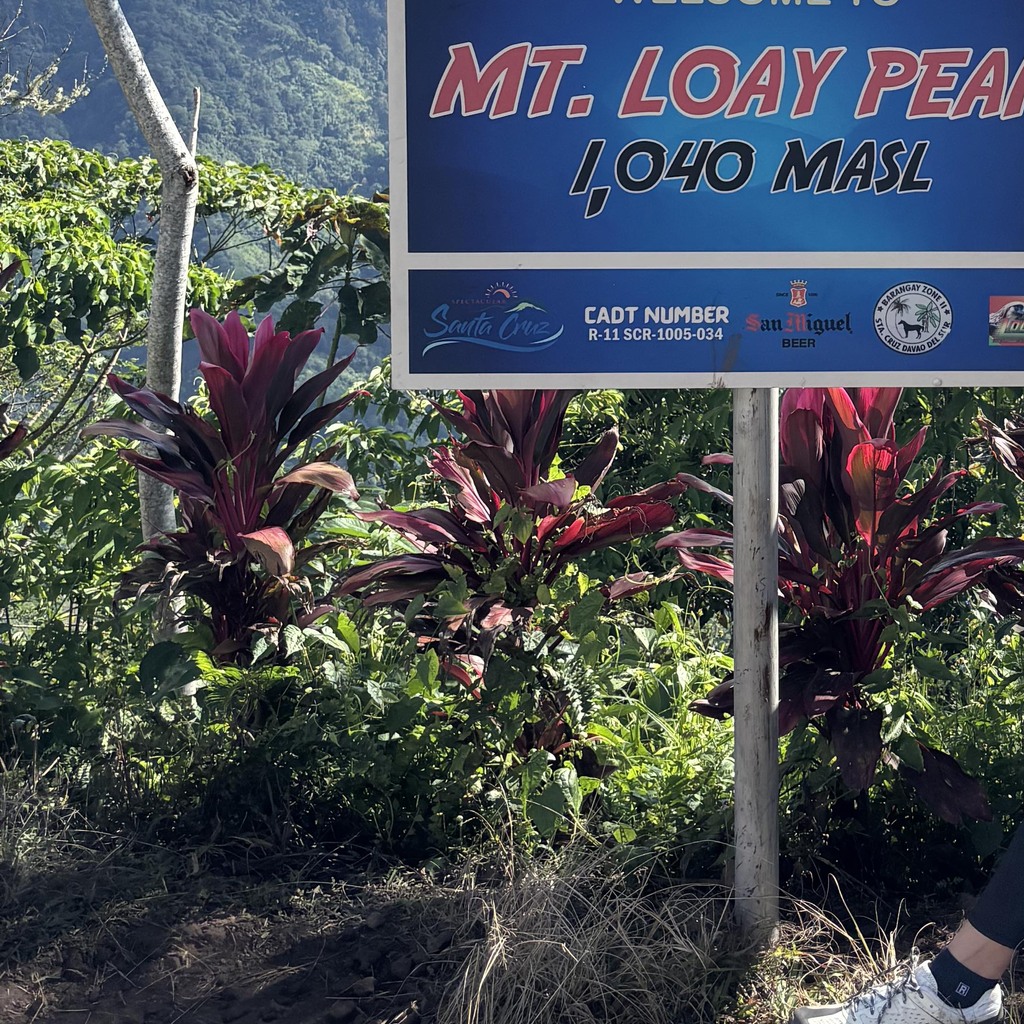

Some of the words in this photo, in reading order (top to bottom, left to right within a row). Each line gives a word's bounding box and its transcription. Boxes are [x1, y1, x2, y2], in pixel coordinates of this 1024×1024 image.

[429, 42, 593, 119] MT.
[618, 46, 846, 119] LOAY
[569, 139, 756, 219] 1,040
[771, 139, 932, 196] MASL
[881, 284, 921, 306] BARANGAY
[922, 285, 942, 302] ZONE
[423, 303, 495, 338] Santa
[498, 313, 550, 340] Cruz
[584, 306, 639, 324] CADT
[644, 306, 730, 325] NUMBER
[745, 312, 783, 334] San
[783, 312, 853, 336] Miguel
[588, 328, 620, 341] R-11
[623, 328, 724, 341] SCR-1005-034
[782, 338, 816, 348] BEER
[875, 318, 884, 336] STA.
[884, 334, 901, 350] CRUZ
[901, 344, 926, 353] DAVAO
[926, 337, 940, 348] DEL
